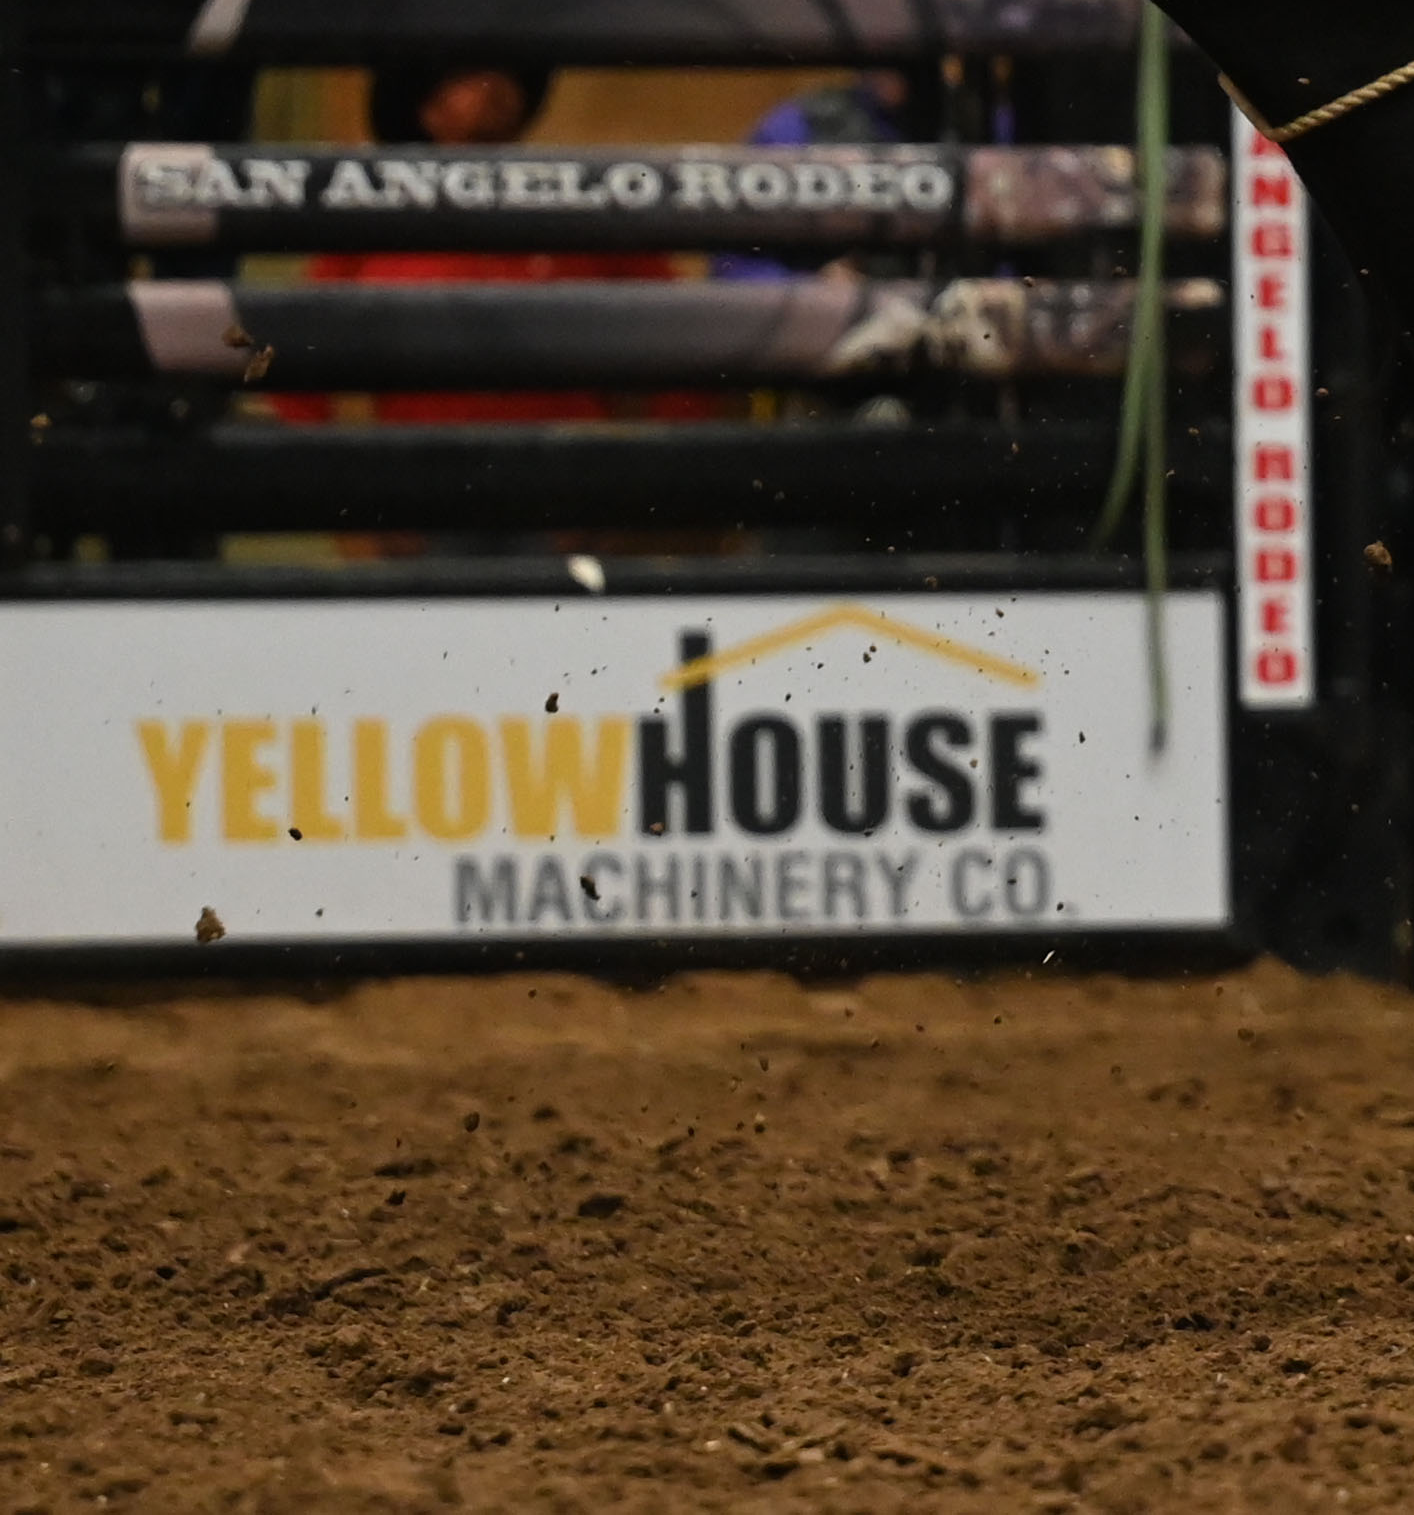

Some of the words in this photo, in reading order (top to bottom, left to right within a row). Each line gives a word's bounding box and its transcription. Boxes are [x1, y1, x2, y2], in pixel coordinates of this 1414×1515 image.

[137, 159, 311, 209] SAN
[320, 159, 663, 210] ANGELO
[672, 159, 956, 211] RODEO
[452, 850, 919, 925] MACHINERY
